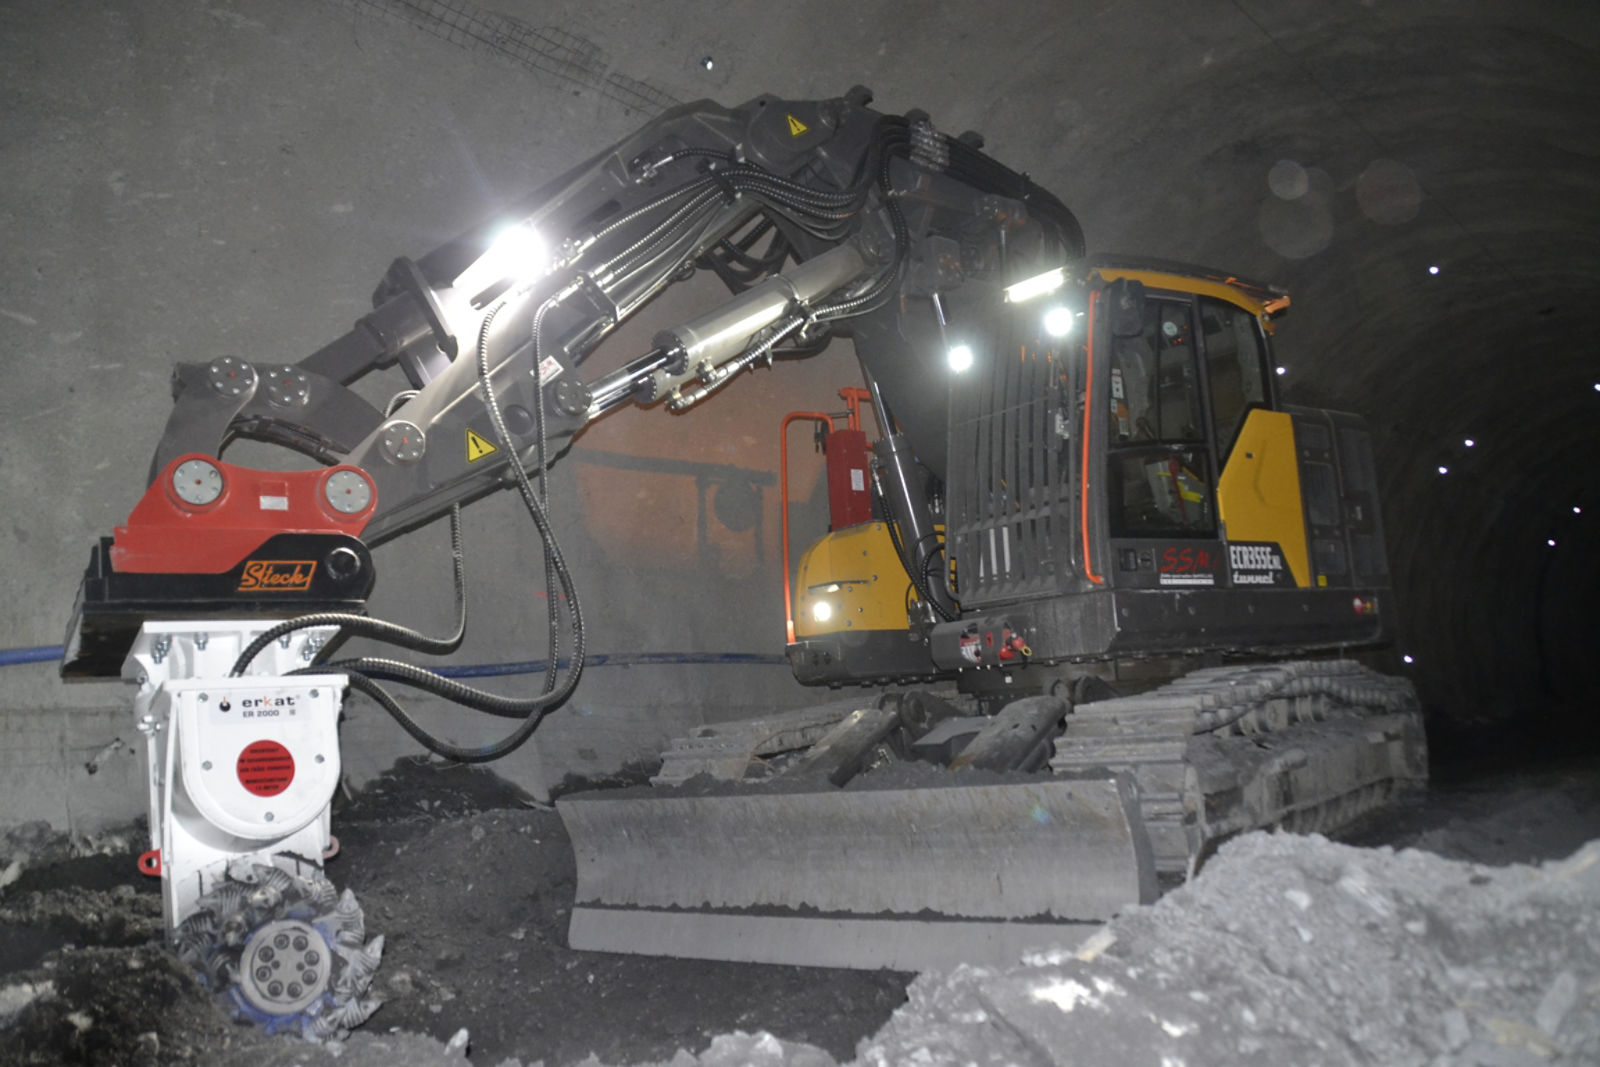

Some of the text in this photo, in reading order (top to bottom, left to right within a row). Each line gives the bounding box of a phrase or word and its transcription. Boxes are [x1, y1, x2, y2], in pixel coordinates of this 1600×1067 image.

[240, 562, 309, 588] Steck
[242, 695, 295, 708] erkat
[243, 710, 254, 718] ER
[257, 709, 279, 717] 2000
